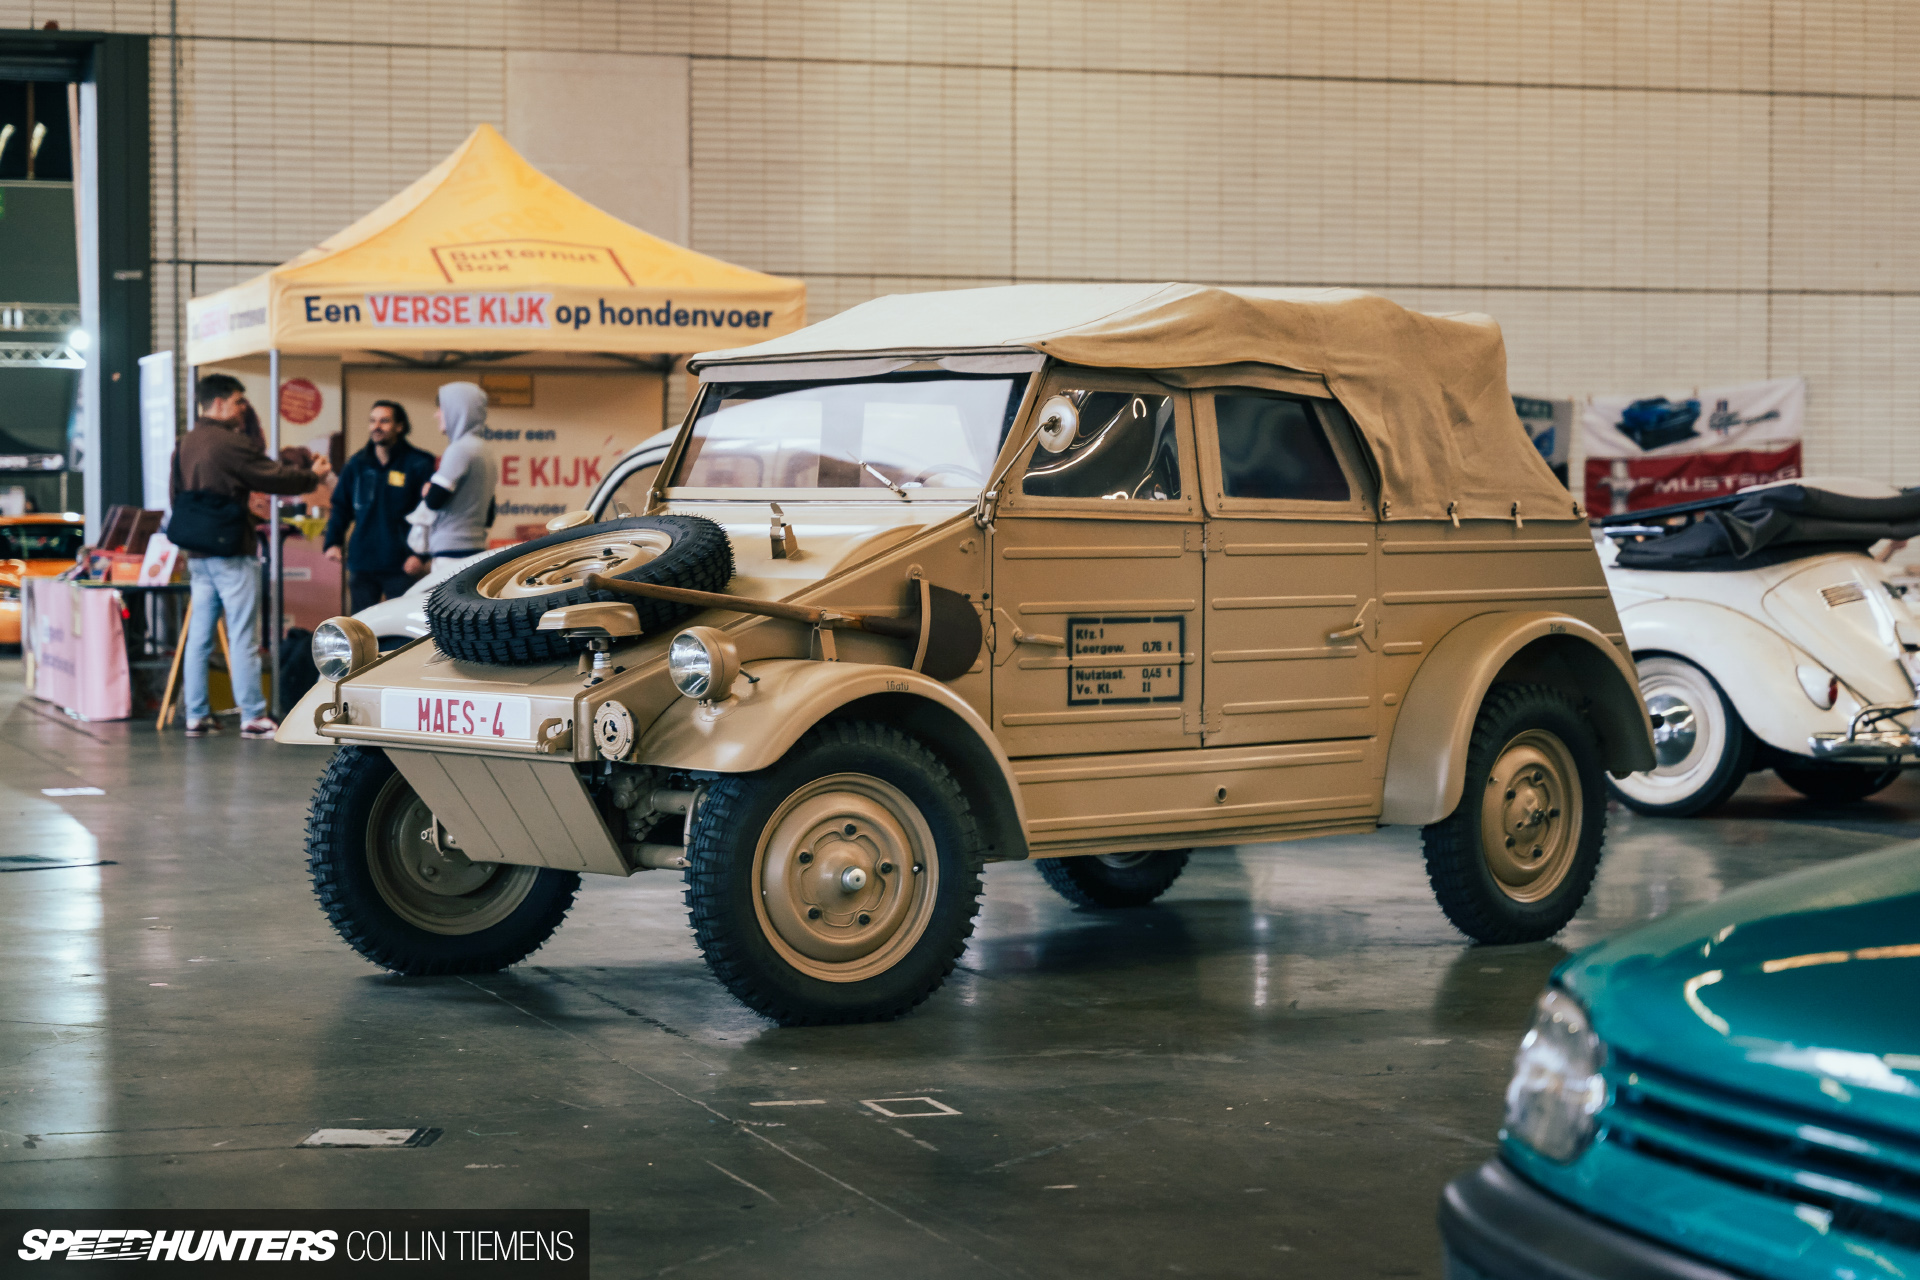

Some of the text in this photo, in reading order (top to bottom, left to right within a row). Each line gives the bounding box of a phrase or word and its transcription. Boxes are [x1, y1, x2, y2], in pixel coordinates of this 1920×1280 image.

[450, 248, 601, 264] Butternut
[455, 263, 512, 273] Box
[304, 295, 774, 330] Een VERSE KIJK op hondenvoer
[480, 425, 556, 441] beer een
[529, 455, 601, 487] KIJK
[418, 697, 505, 737] MAES-4
